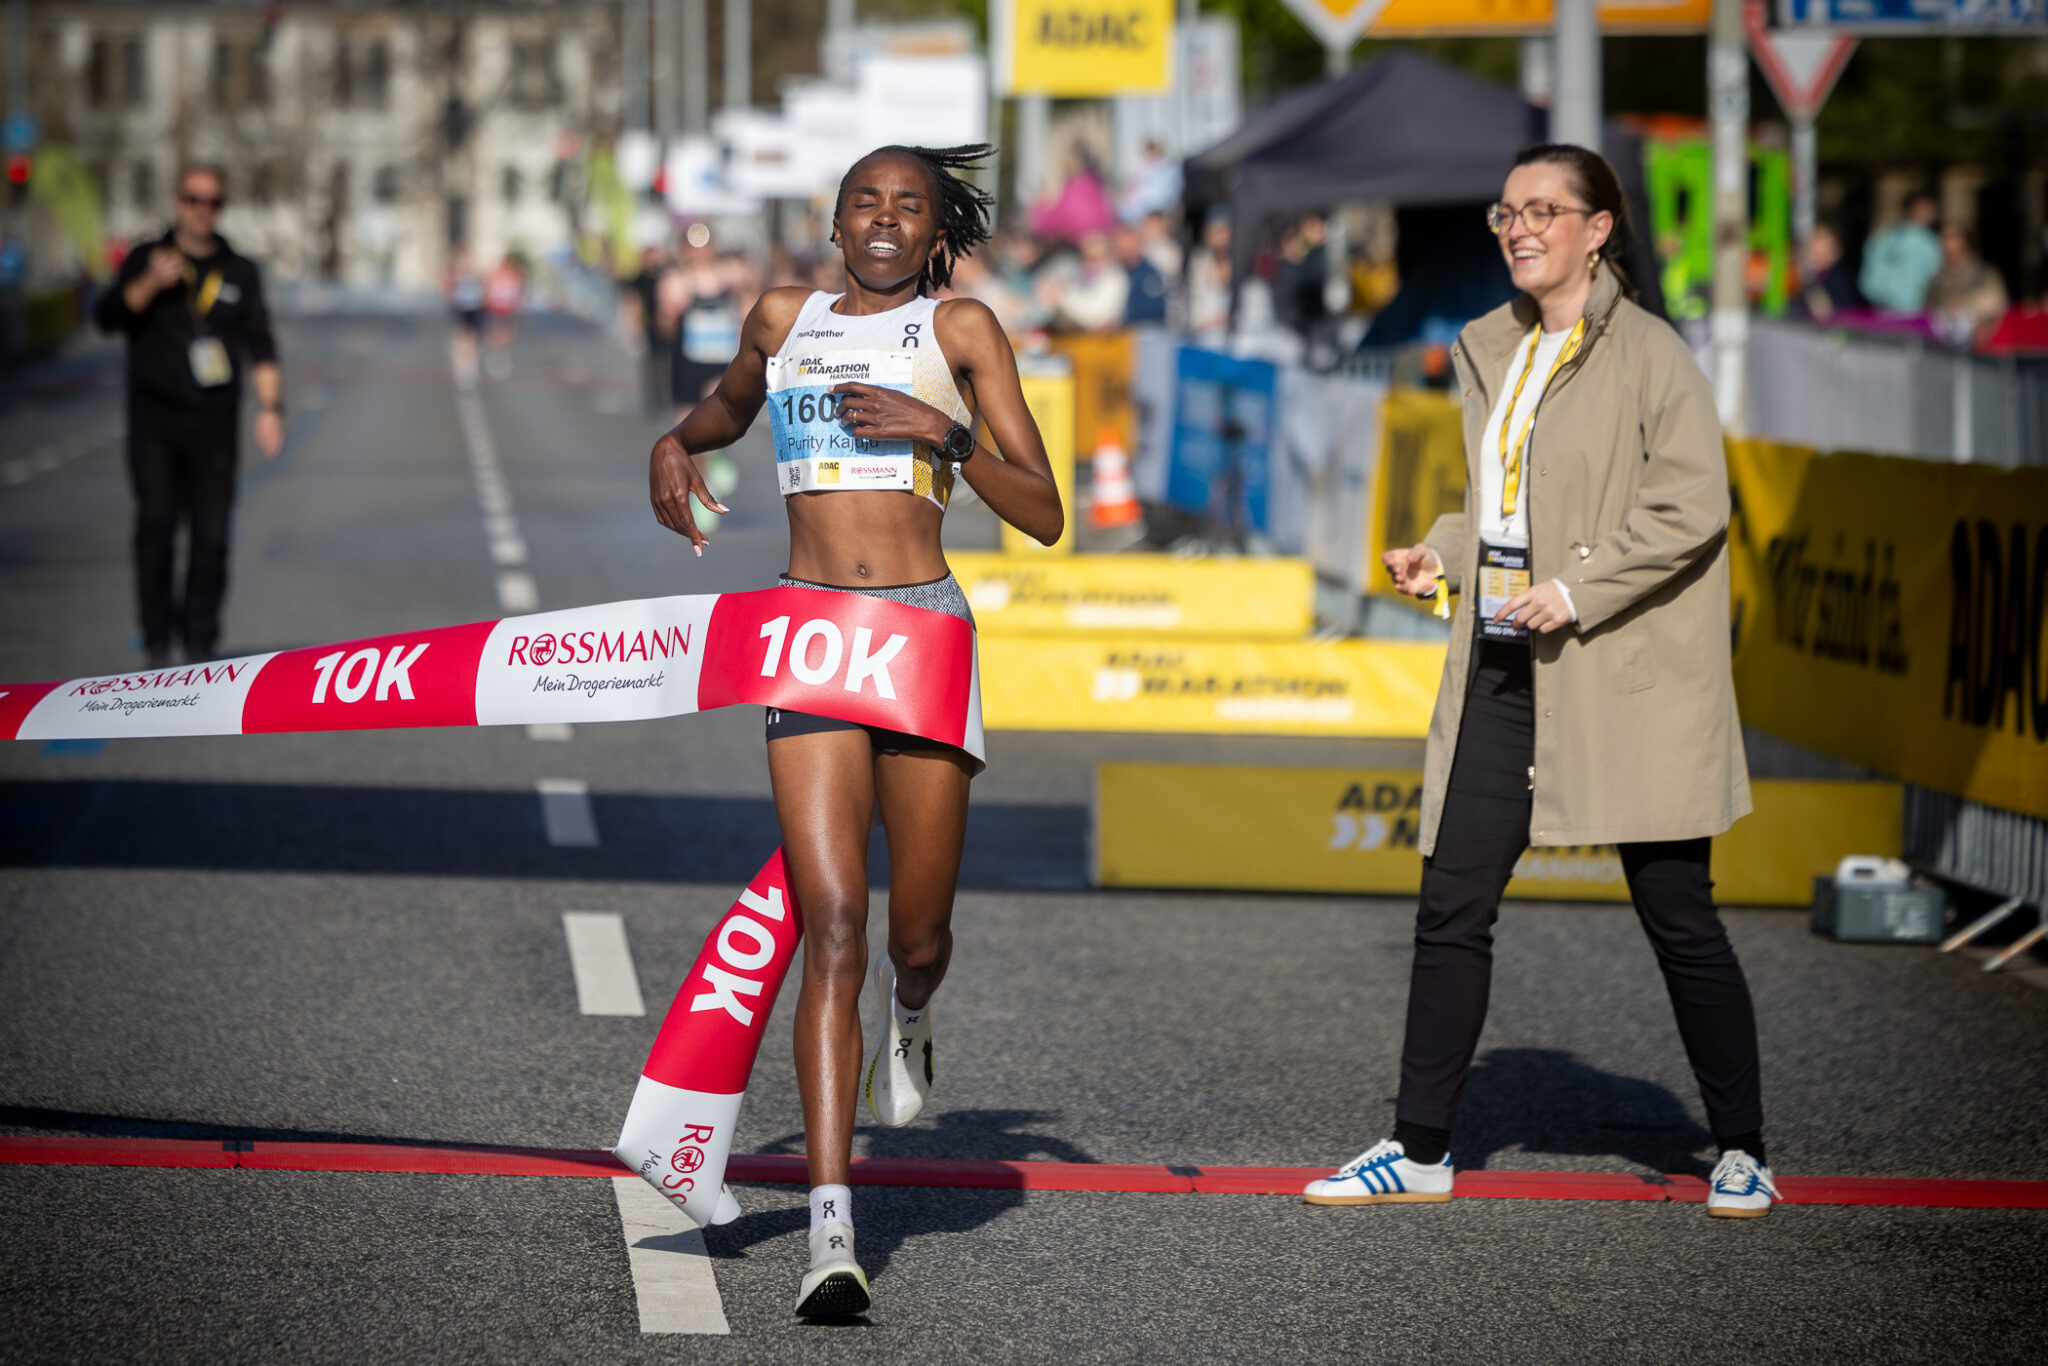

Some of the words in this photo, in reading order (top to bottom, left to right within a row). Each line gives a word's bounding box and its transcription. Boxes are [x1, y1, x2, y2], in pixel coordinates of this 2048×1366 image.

[797, 329, 845, 339] run2gether
[800, 357, 823, 367] ADAC
[806, 363, 871, 375] MARATHON
[829, 372, 870, 381] HANNOVER
[788, 435, 825, 453] Purity
[818, 461, 840, 470] ADAC
[850, 467, 898, 475] ROSSMANN
[508, 623, 693, 667] ROSSMANN
[759, 614, 909, 701] 10K
[69, 662, 248, 697] ROSSMANN
[311, 642, 431, 704] 10K
[533, 673, 567, 694] Mein
[567, 671, 666, 698] Drogeriemarkt
[79, 699, 110, 713] Mein
[110, 693, 201, 717] Drogeriemarkt
[1338, 783, 1423, 813] ADA
[689, 885, 786, 1027] 10K
[657, 1123, 714, 1205] ROSS
